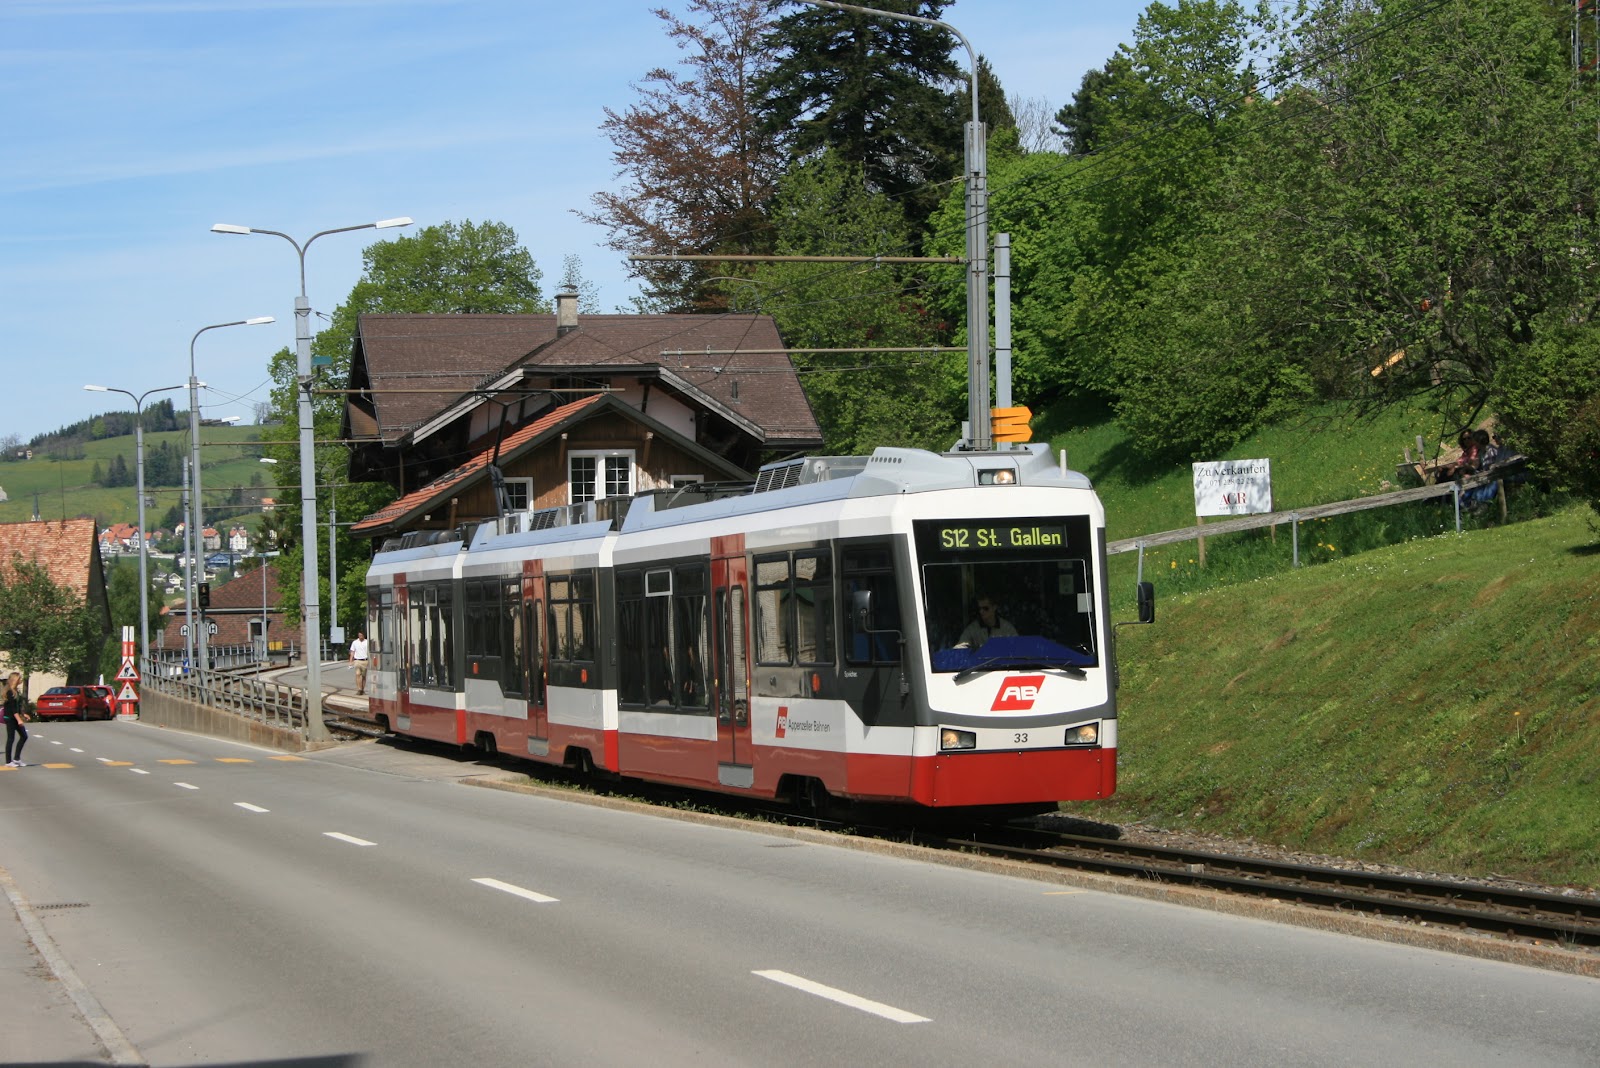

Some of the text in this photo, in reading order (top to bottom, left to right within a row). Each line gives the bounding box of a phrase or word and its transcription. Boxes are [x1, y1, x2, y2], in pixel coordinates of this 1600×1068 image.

[1198, 464, 1266, 477] Zu verkaufen
[941, 527, 1061, 547] S12 St. Gallen
[1001, 685, 1039, 702] AB
[788, 719, 831, 732] Appenzeller Bahnen
[1014, 732, 1028, 743] 33
